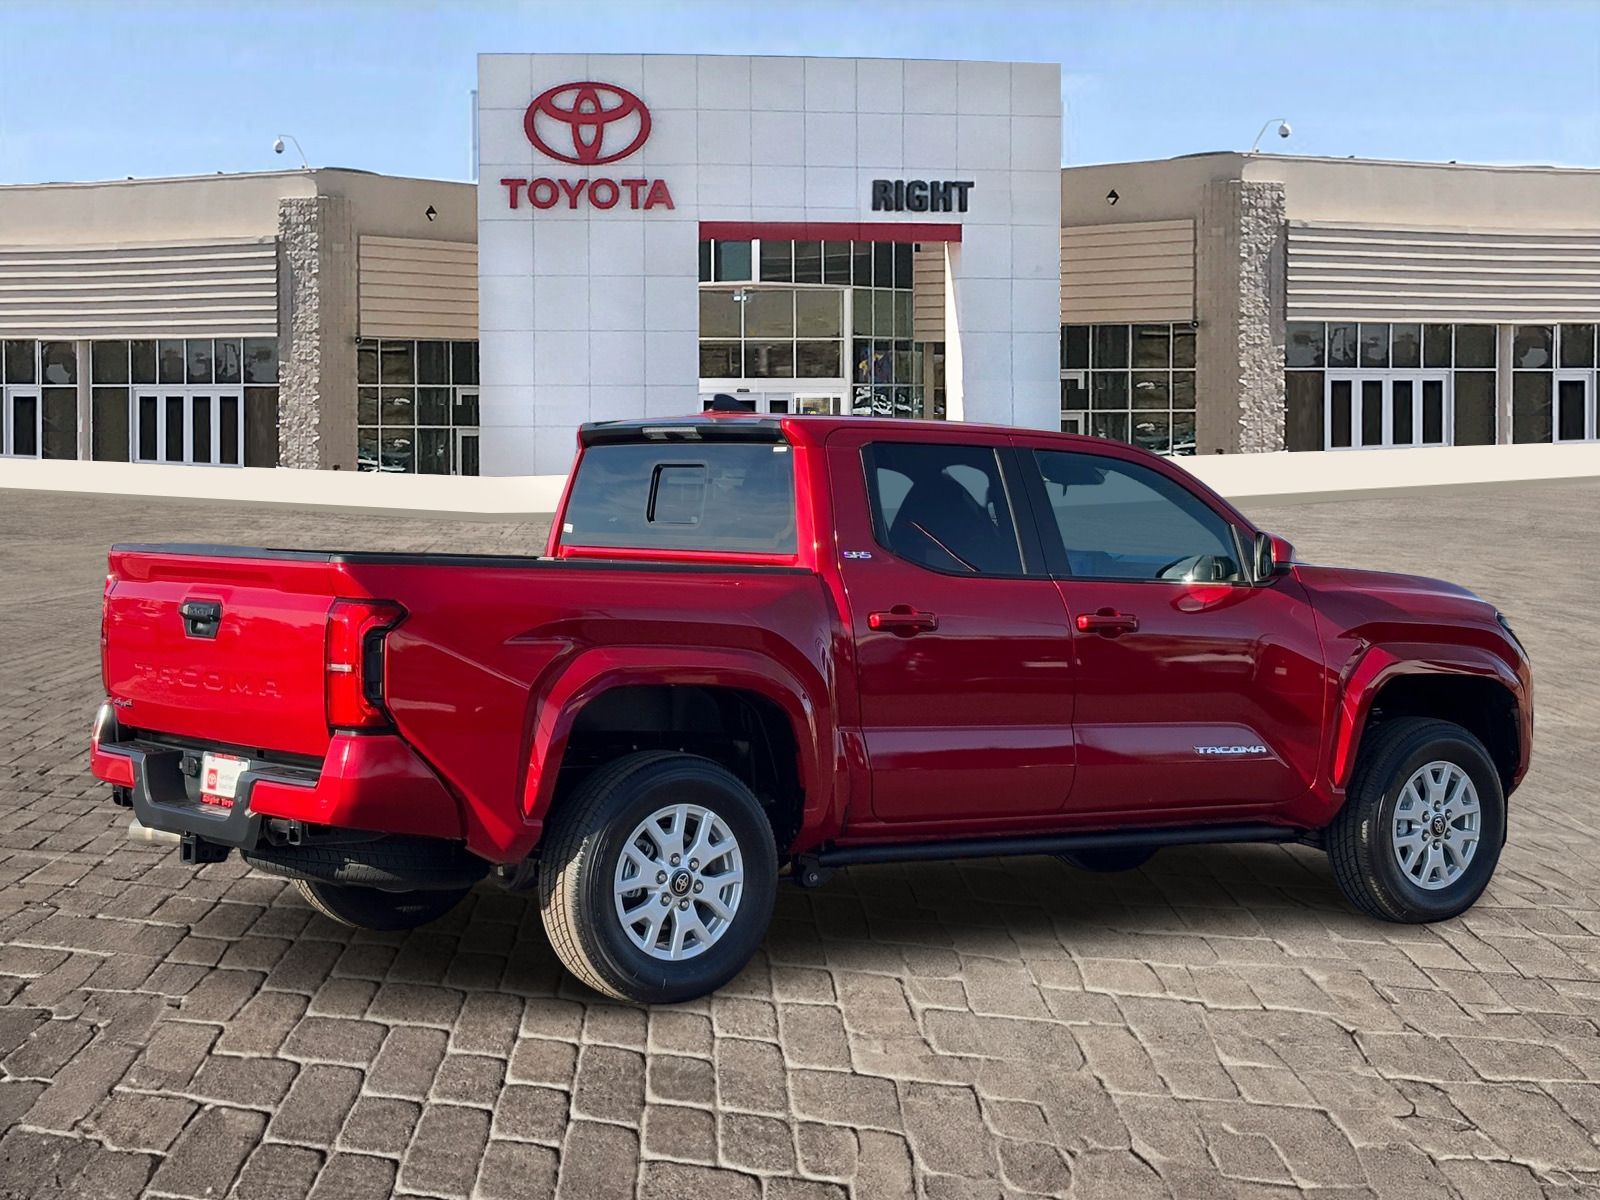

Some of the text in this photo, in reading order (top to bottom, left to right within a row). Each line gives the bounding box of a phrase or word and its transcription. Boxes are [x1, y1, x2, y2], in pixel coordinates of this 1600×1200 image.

[501, 179, 675, 210] TOYOTA
[872, 180, 975, 213] RIGHT
[134, 663, 281, 698] TACOMA
[1194, 745, 1267, 754] TACOMA
